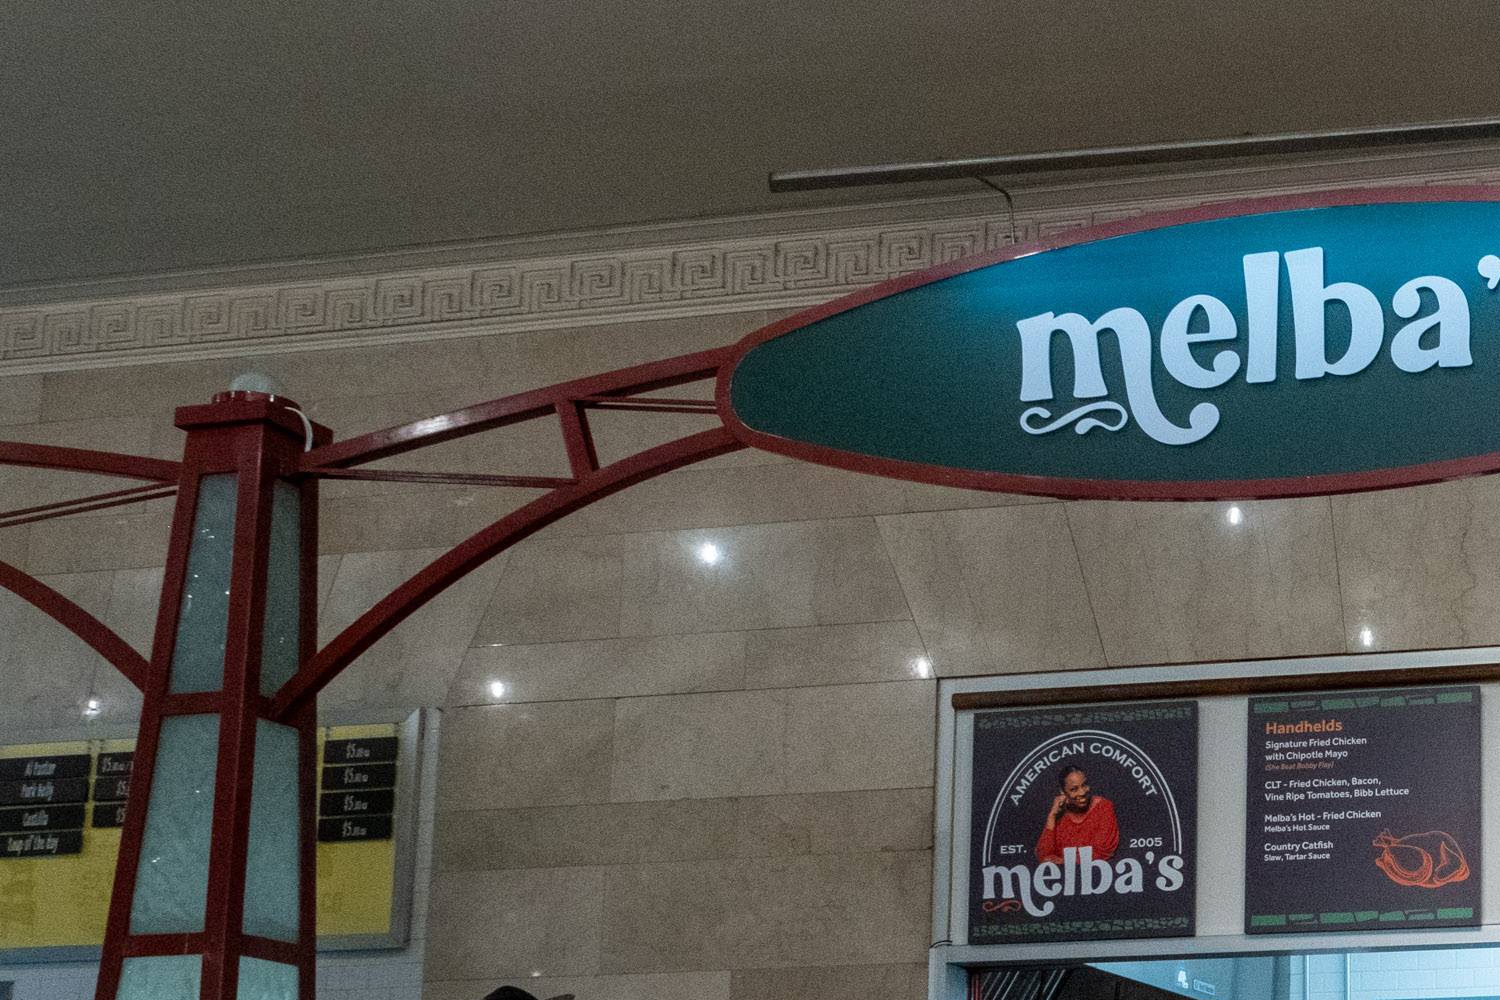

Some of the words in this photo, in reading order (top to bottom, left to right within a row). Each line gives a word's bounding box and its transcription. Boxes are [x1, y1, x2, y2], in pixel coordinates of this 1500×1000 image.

[1266, 720, 1343, 734] Handhelds
[1265, 740, 1307, 749] Signature
[1309, 738, 1330, 747] Fried
[1332, 737, 1367, 746] Chicken
[1265, 752, 1284, 760] with
[1286, 751, 1323, 761] Chipotle
[1325, 750, 1348, 760] Mayo
[1010, 742, 1085, 806] AMERICAN
[1090, 743, 1157, 796] COMFORT
[1265, 781, 1281, 790] CLT
[1289, 779, 1310, 788] Fried
[1312, 778, 1350, 787] Chicken,
[1352, 777, 1381, 785] Bacon,
[1265, 792, 1284, 801] Vine
[1286, 792, 1305, 801] Ripe
[1307, 790, 1352, 799] Tomatoes,
[1354, 788, 1373, 797] Bibb
[1375, 788, 1409, 796] Lettuce
[1265, 814, 1297, 822] Melba's
[1299, 813, 1315, 821] Hot
[1323, 811, 1344, 820] Fried
[1346, 810, 1381, 819] Chicken
[1130, 838, 1163, 848] 2005
[1264, 842, 1300, 852] Country
[1302, 840, 1333, 850] Catfish
[1000, 845, 1027, 854] EST.
[1264, 853, 1284, 862] Slaw,
[1285, 852, 1306, 860] Tartar
[982, 846, 1184, 917] melba's
